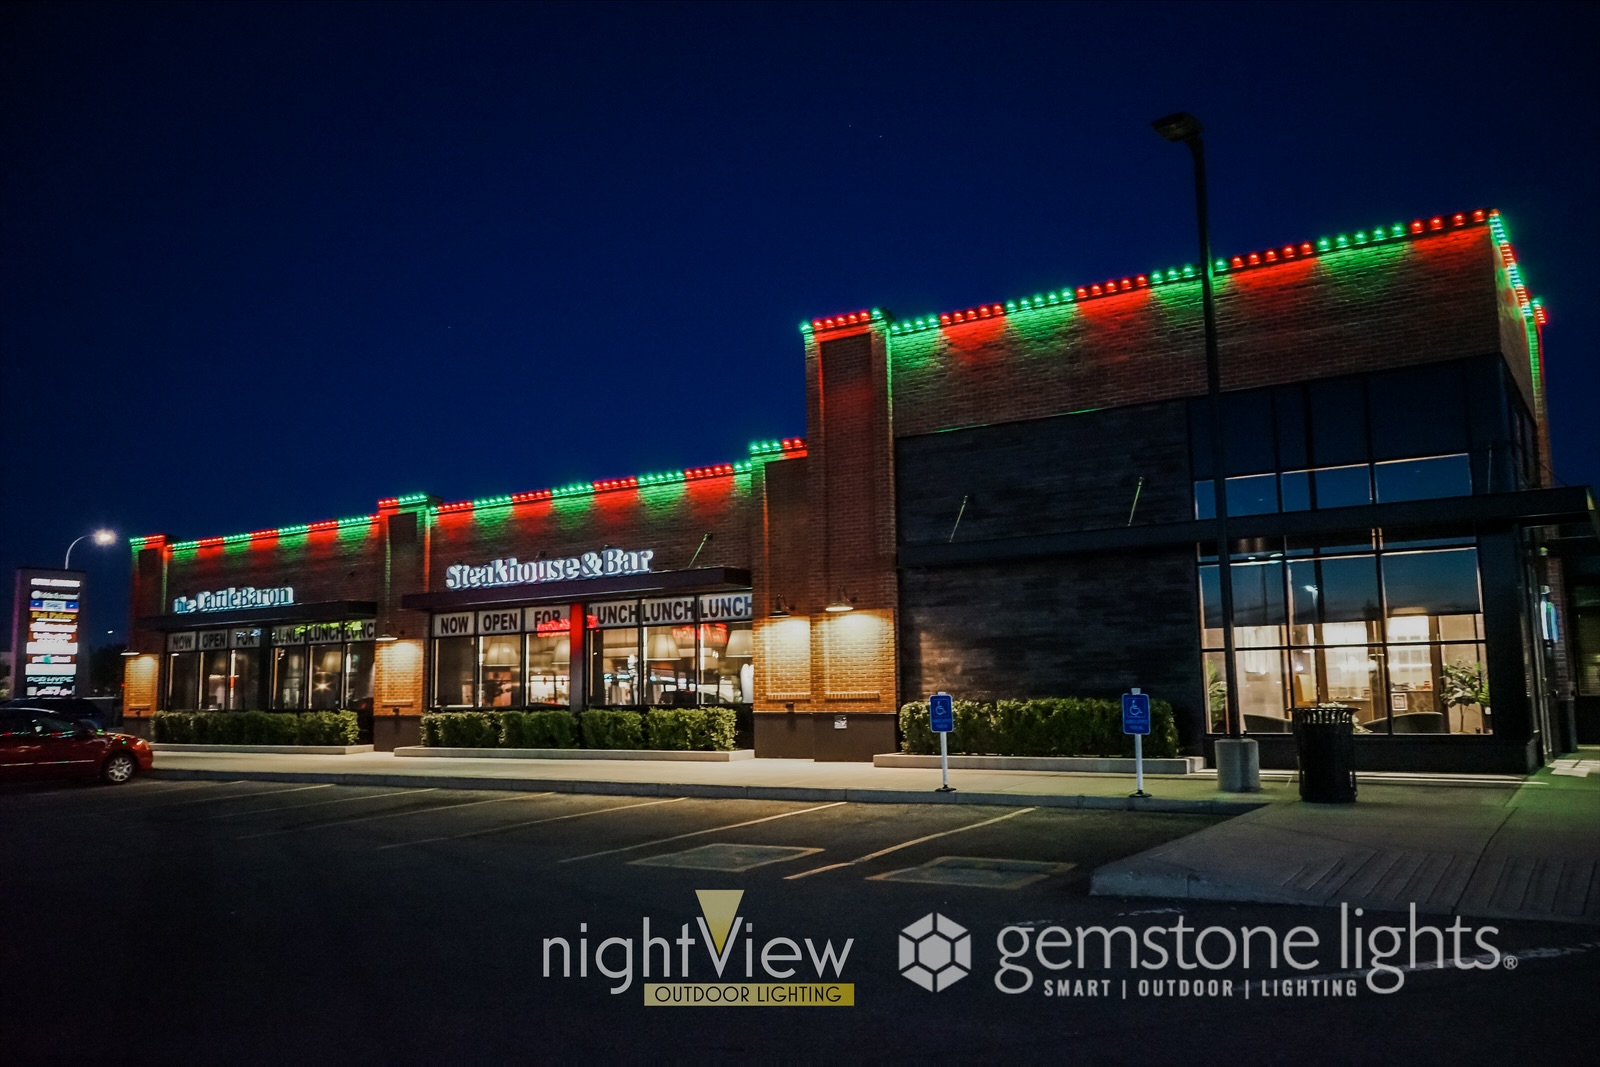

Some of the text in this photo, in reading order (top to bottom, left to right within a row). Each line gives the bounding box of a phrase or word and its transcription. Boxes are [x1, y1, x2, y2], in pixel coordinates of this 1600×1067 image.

[440, 616, 469, 634] NOW
[483, 613, 518, 631] OPEN
[534, 609, 561, 628] FOR
[642, 601, 694, 622] LUNCH
[202, 633, 226, 648] OPEN
